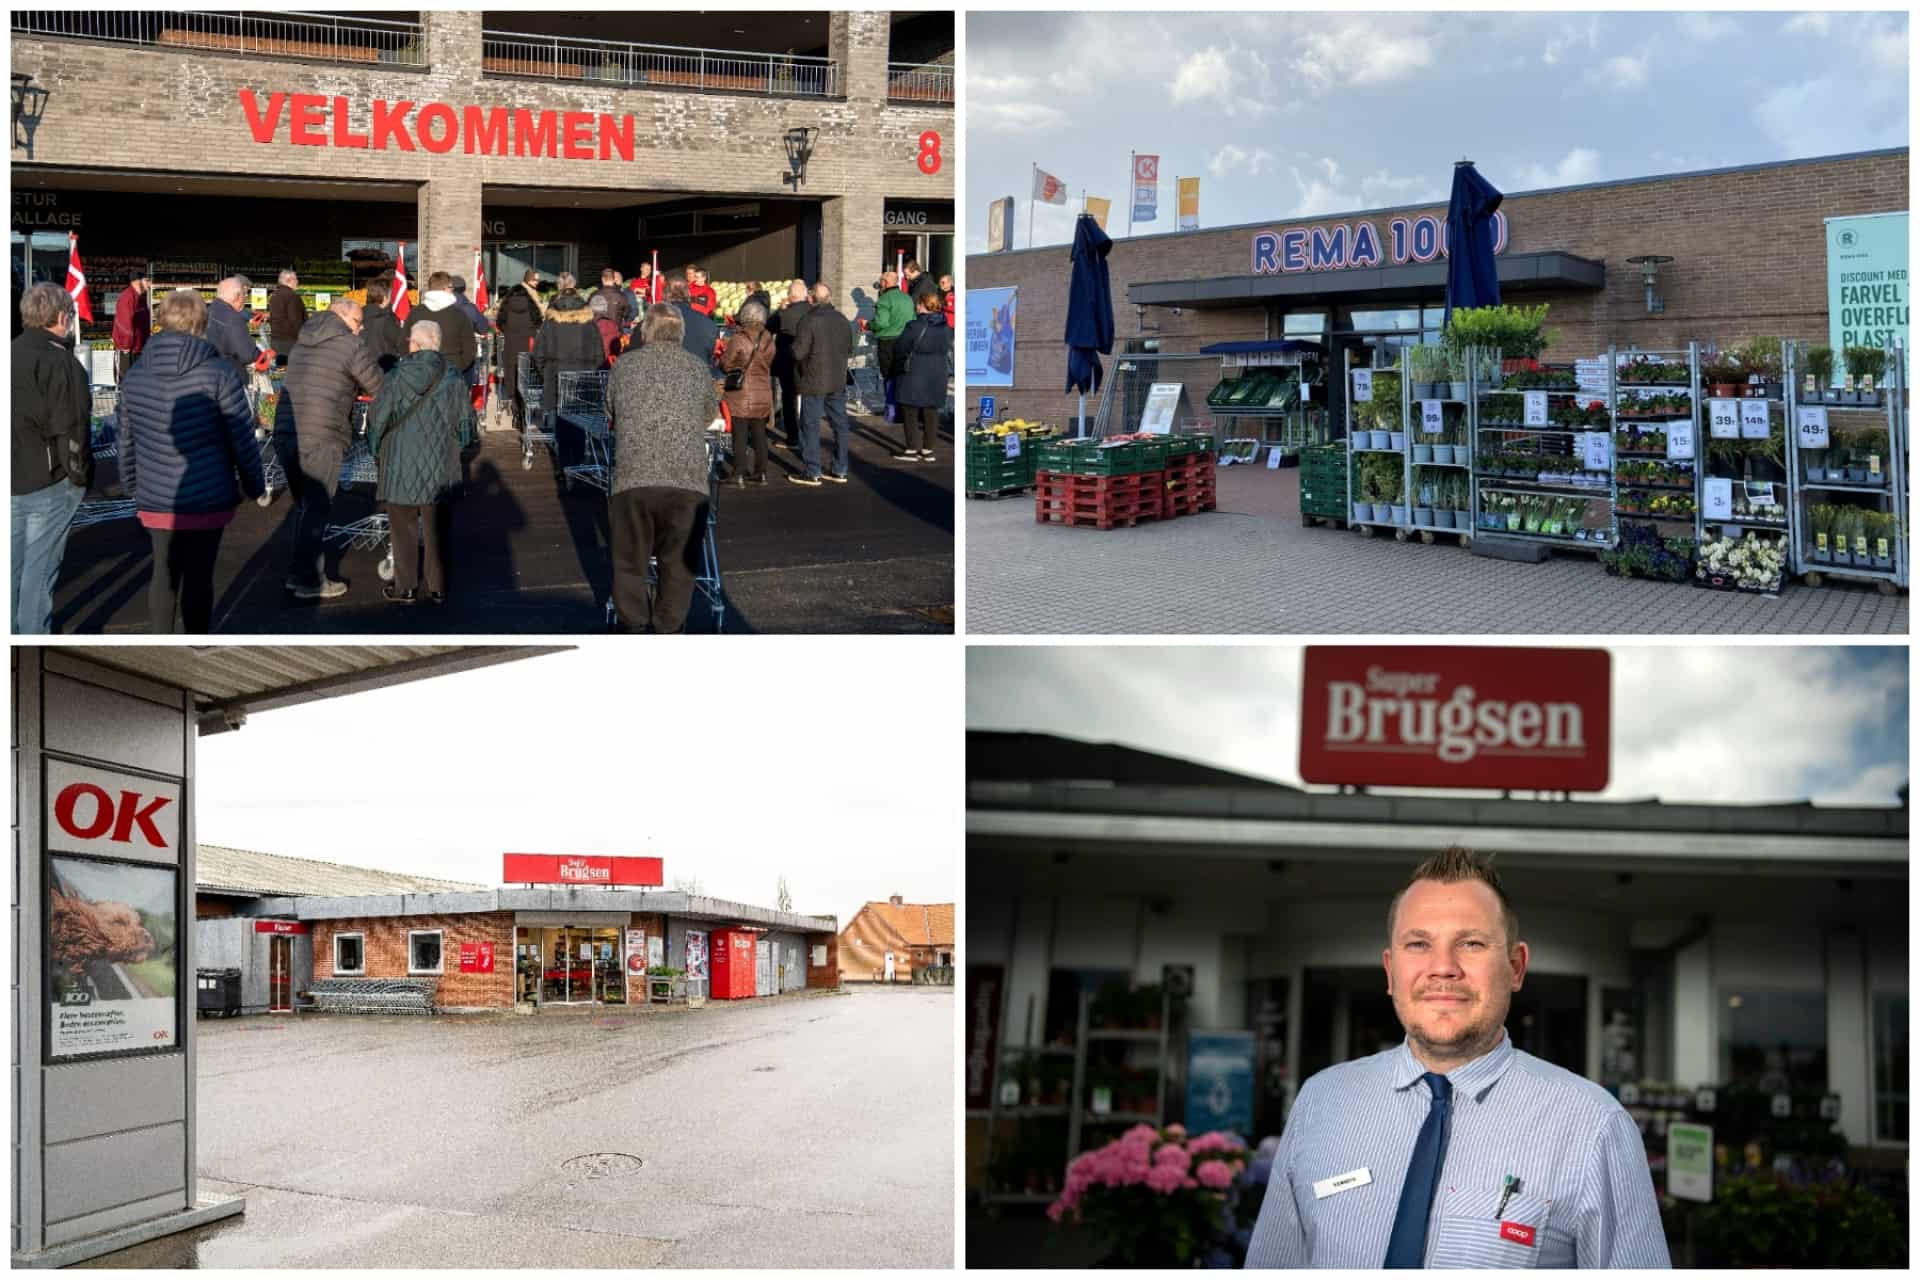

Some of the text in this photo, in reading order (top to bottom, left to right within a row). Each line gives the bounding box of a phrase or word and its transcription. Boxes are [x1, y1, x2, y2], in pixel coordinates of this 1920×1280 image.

[238, 89, 635, 162] VELKOMMEN
[917, 130, 942, 174] 8
[1252, 221, 1381, 273] REMA
[1840, 269, 1907, 283] DISCOUNT MED
[1841, 283, 1902, 304] FARVEL
[1842, 328, 1895, 349] PLAST
[1365, 665, 1440, 695] Super
[1325, 681, 1585, 763] Brugsen
[55, 783, 173, 848] OK
[561, 864, 609, 880] Brugsen
[153, 1030, 168, 1040] OK
[1507, 1227, 1529, 1238] coop
